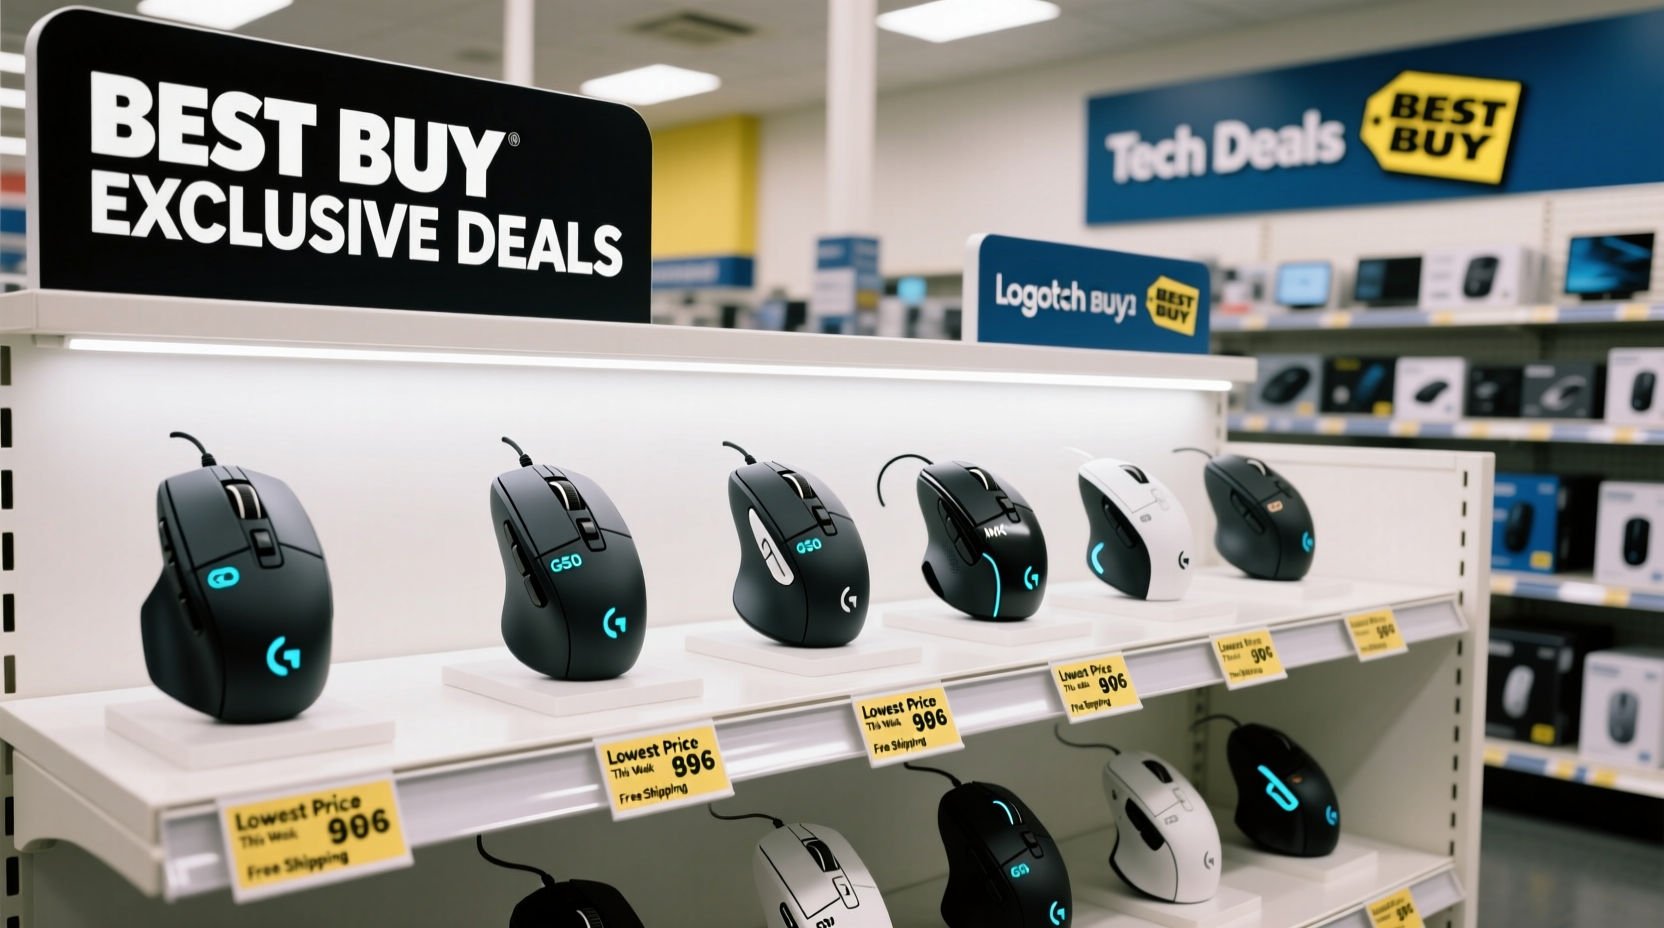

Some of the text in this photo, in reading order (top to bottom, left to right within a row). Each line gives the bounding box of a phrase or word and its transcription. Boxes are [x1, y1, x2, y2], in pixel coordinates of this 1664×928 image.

[91, 71, 317, 178] BEST
[1390, 93, 1507, 127] BEST
[1104, 108, 1347, 185] Tech Deals
[1389, 127, 1491, 160] BUY
[91, 169, 623, 278] EXCLUSIVE DEALS
[1156, 287, 1195, 308] BEST
[1155, 303, 1190, 324] BUY
[550, 553, 582, 573] G50
[1098, 672, 1128, 694] 906
[861, 695, 937, 720] Lowest Price
[606, 736, 699, 765] Lowest Price
[235, 793, 362, 832] Lowest Price
[619, 792, 642, 805] Free
[246, 850, 350, 881] Free Shipping
